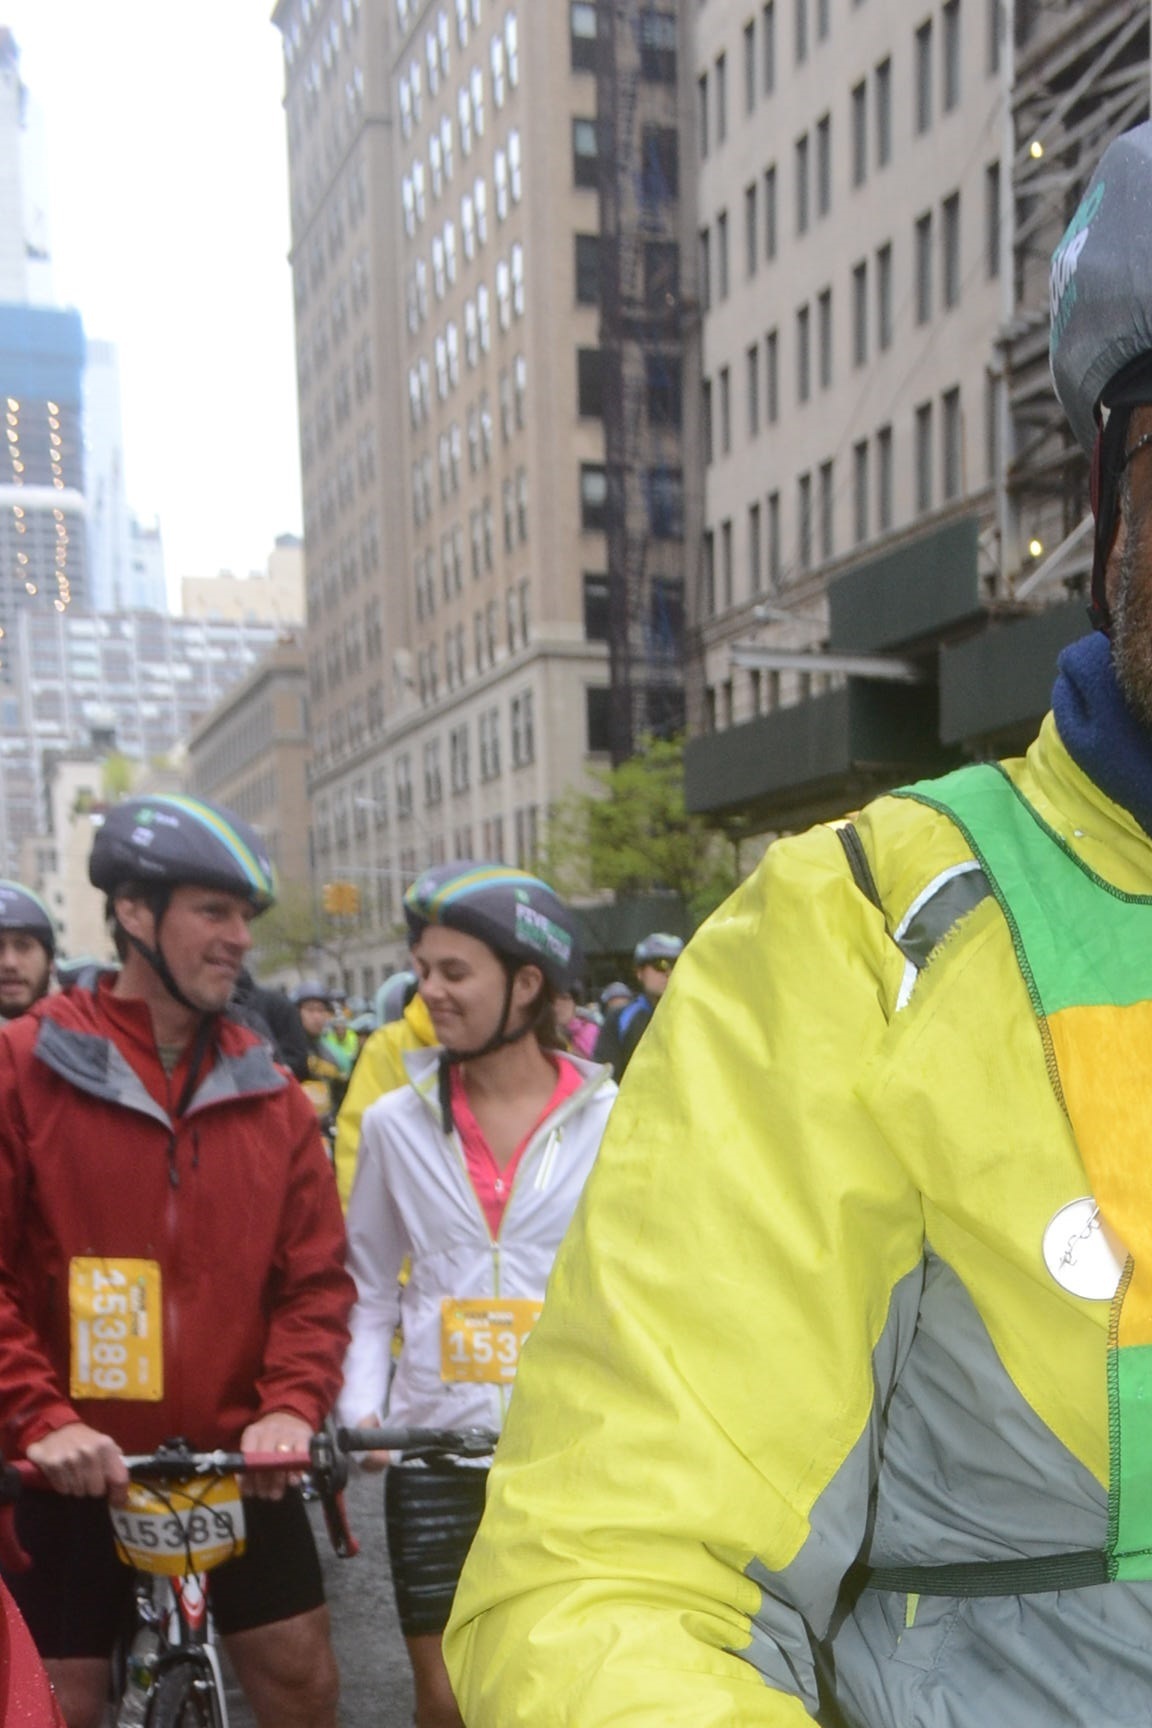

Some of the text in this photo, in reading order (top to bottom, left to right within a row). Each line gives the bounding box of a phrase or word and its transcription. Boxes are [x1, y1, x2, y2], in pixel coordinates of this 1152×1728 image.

[92, 1268, 128, 1390] 15389
[449, 1330, 531, 1364] 153
[118, 1510, 234, 1548] 15389
